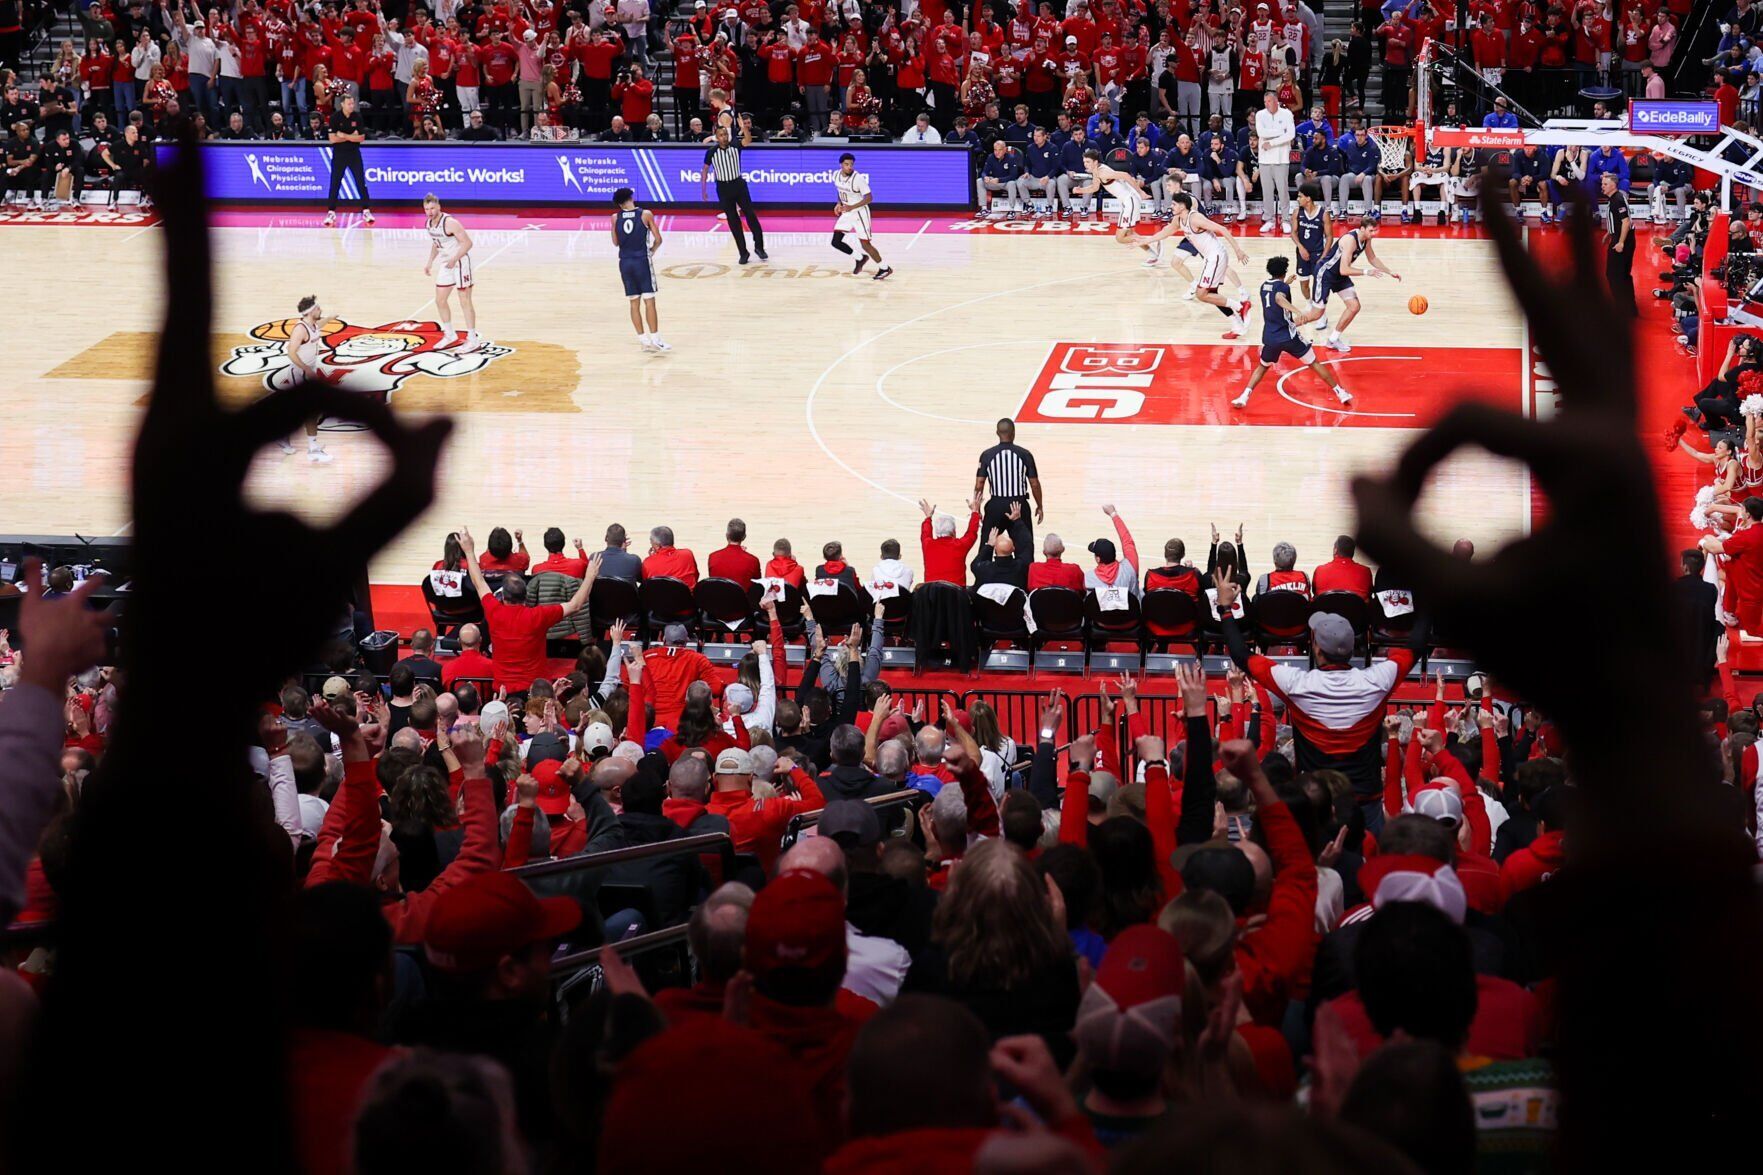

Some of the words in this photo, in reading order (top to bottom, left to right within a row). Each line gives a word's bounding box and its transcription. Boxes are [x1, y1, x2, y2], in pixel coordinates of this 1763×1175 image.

[1650, 110, 1712, 126] EideBailly
[262, 155, 304, 163] Nebraska
[1667, 146, 1704, 162] LEGACY
[574, 157, 617, 165] Nebraska
[266, 165, 313, 173] Chiropractic
[578, 167, 626, 175] Chiropractic
[270, 174, 316, 183] Physicians
[364, 167, 465, 185] Chiropractic
[467, 168, 525, 183] Works!
[582, 176, 629, 185] Physicians
[623, 219, 634, 235] 0
[949, 219, 1111, 232] #GBR
[1304, 229, 1311, 239] 5
[1265, 292, 1271, 308] 1
